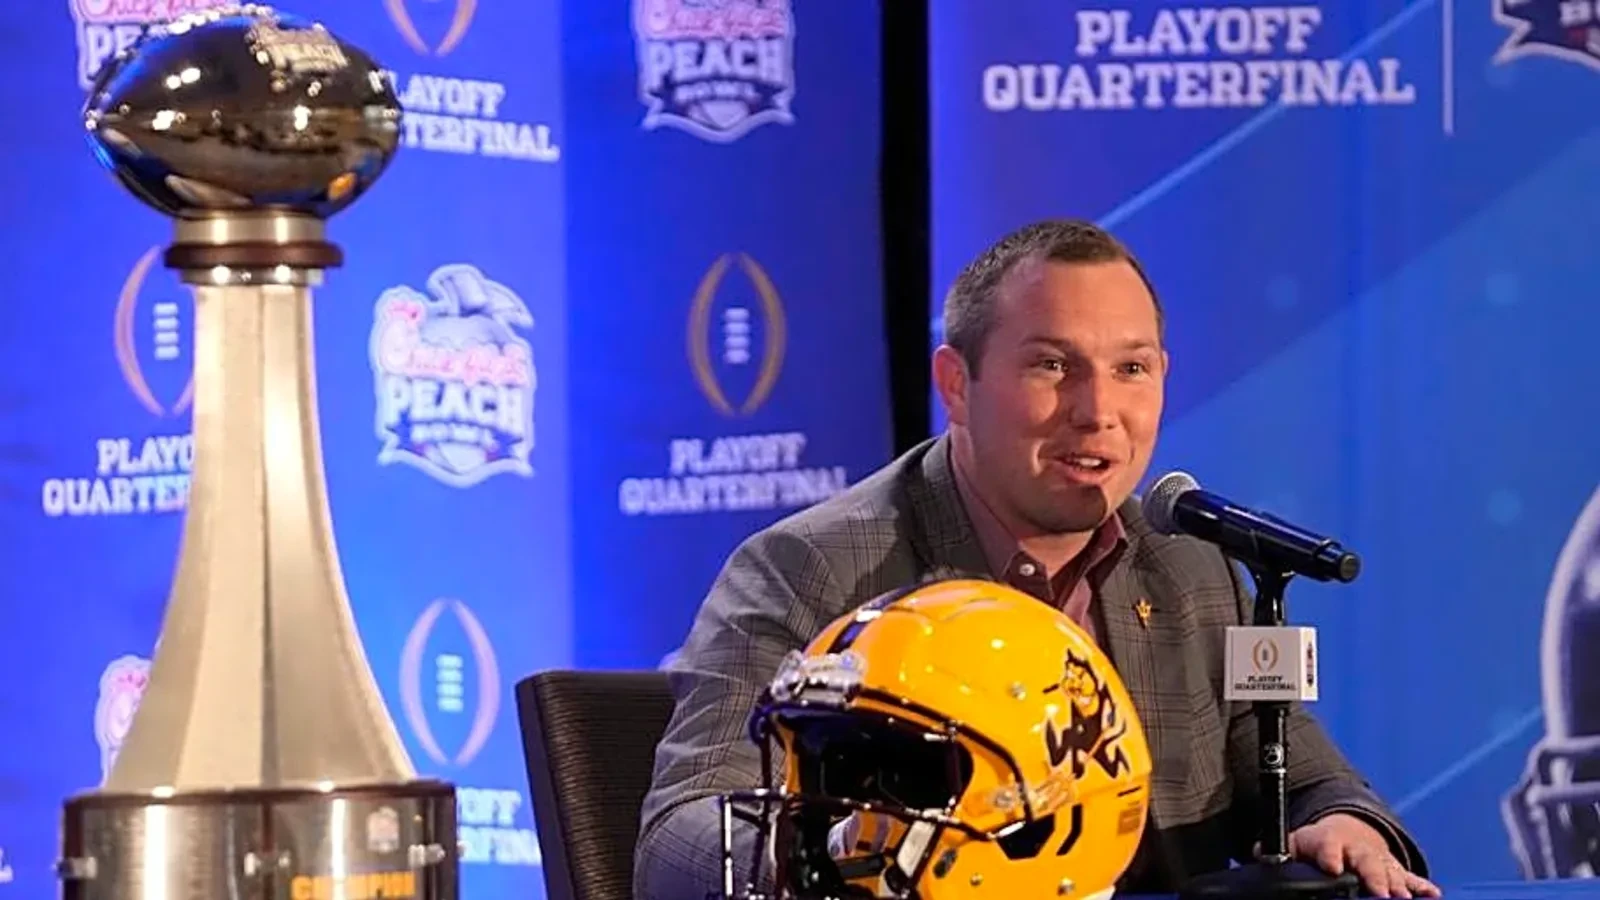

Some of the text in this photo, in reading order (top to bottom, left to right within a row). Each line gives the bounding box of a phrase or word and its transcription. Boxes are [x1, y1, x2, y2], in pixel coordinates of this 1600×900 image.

[1075, 7, 1322, 56] PLAYOFF
[644, 40, 785, 90] PEACH
[983, 58, 1416, 111] QUARTERFINAL
[400, 111, 560, 163] TERFINAL
[383, 376, 526, 437] PEACH
[96, 434, 195, 476] PLAYO
[670, 432, 806, 474] PLAYOFF
